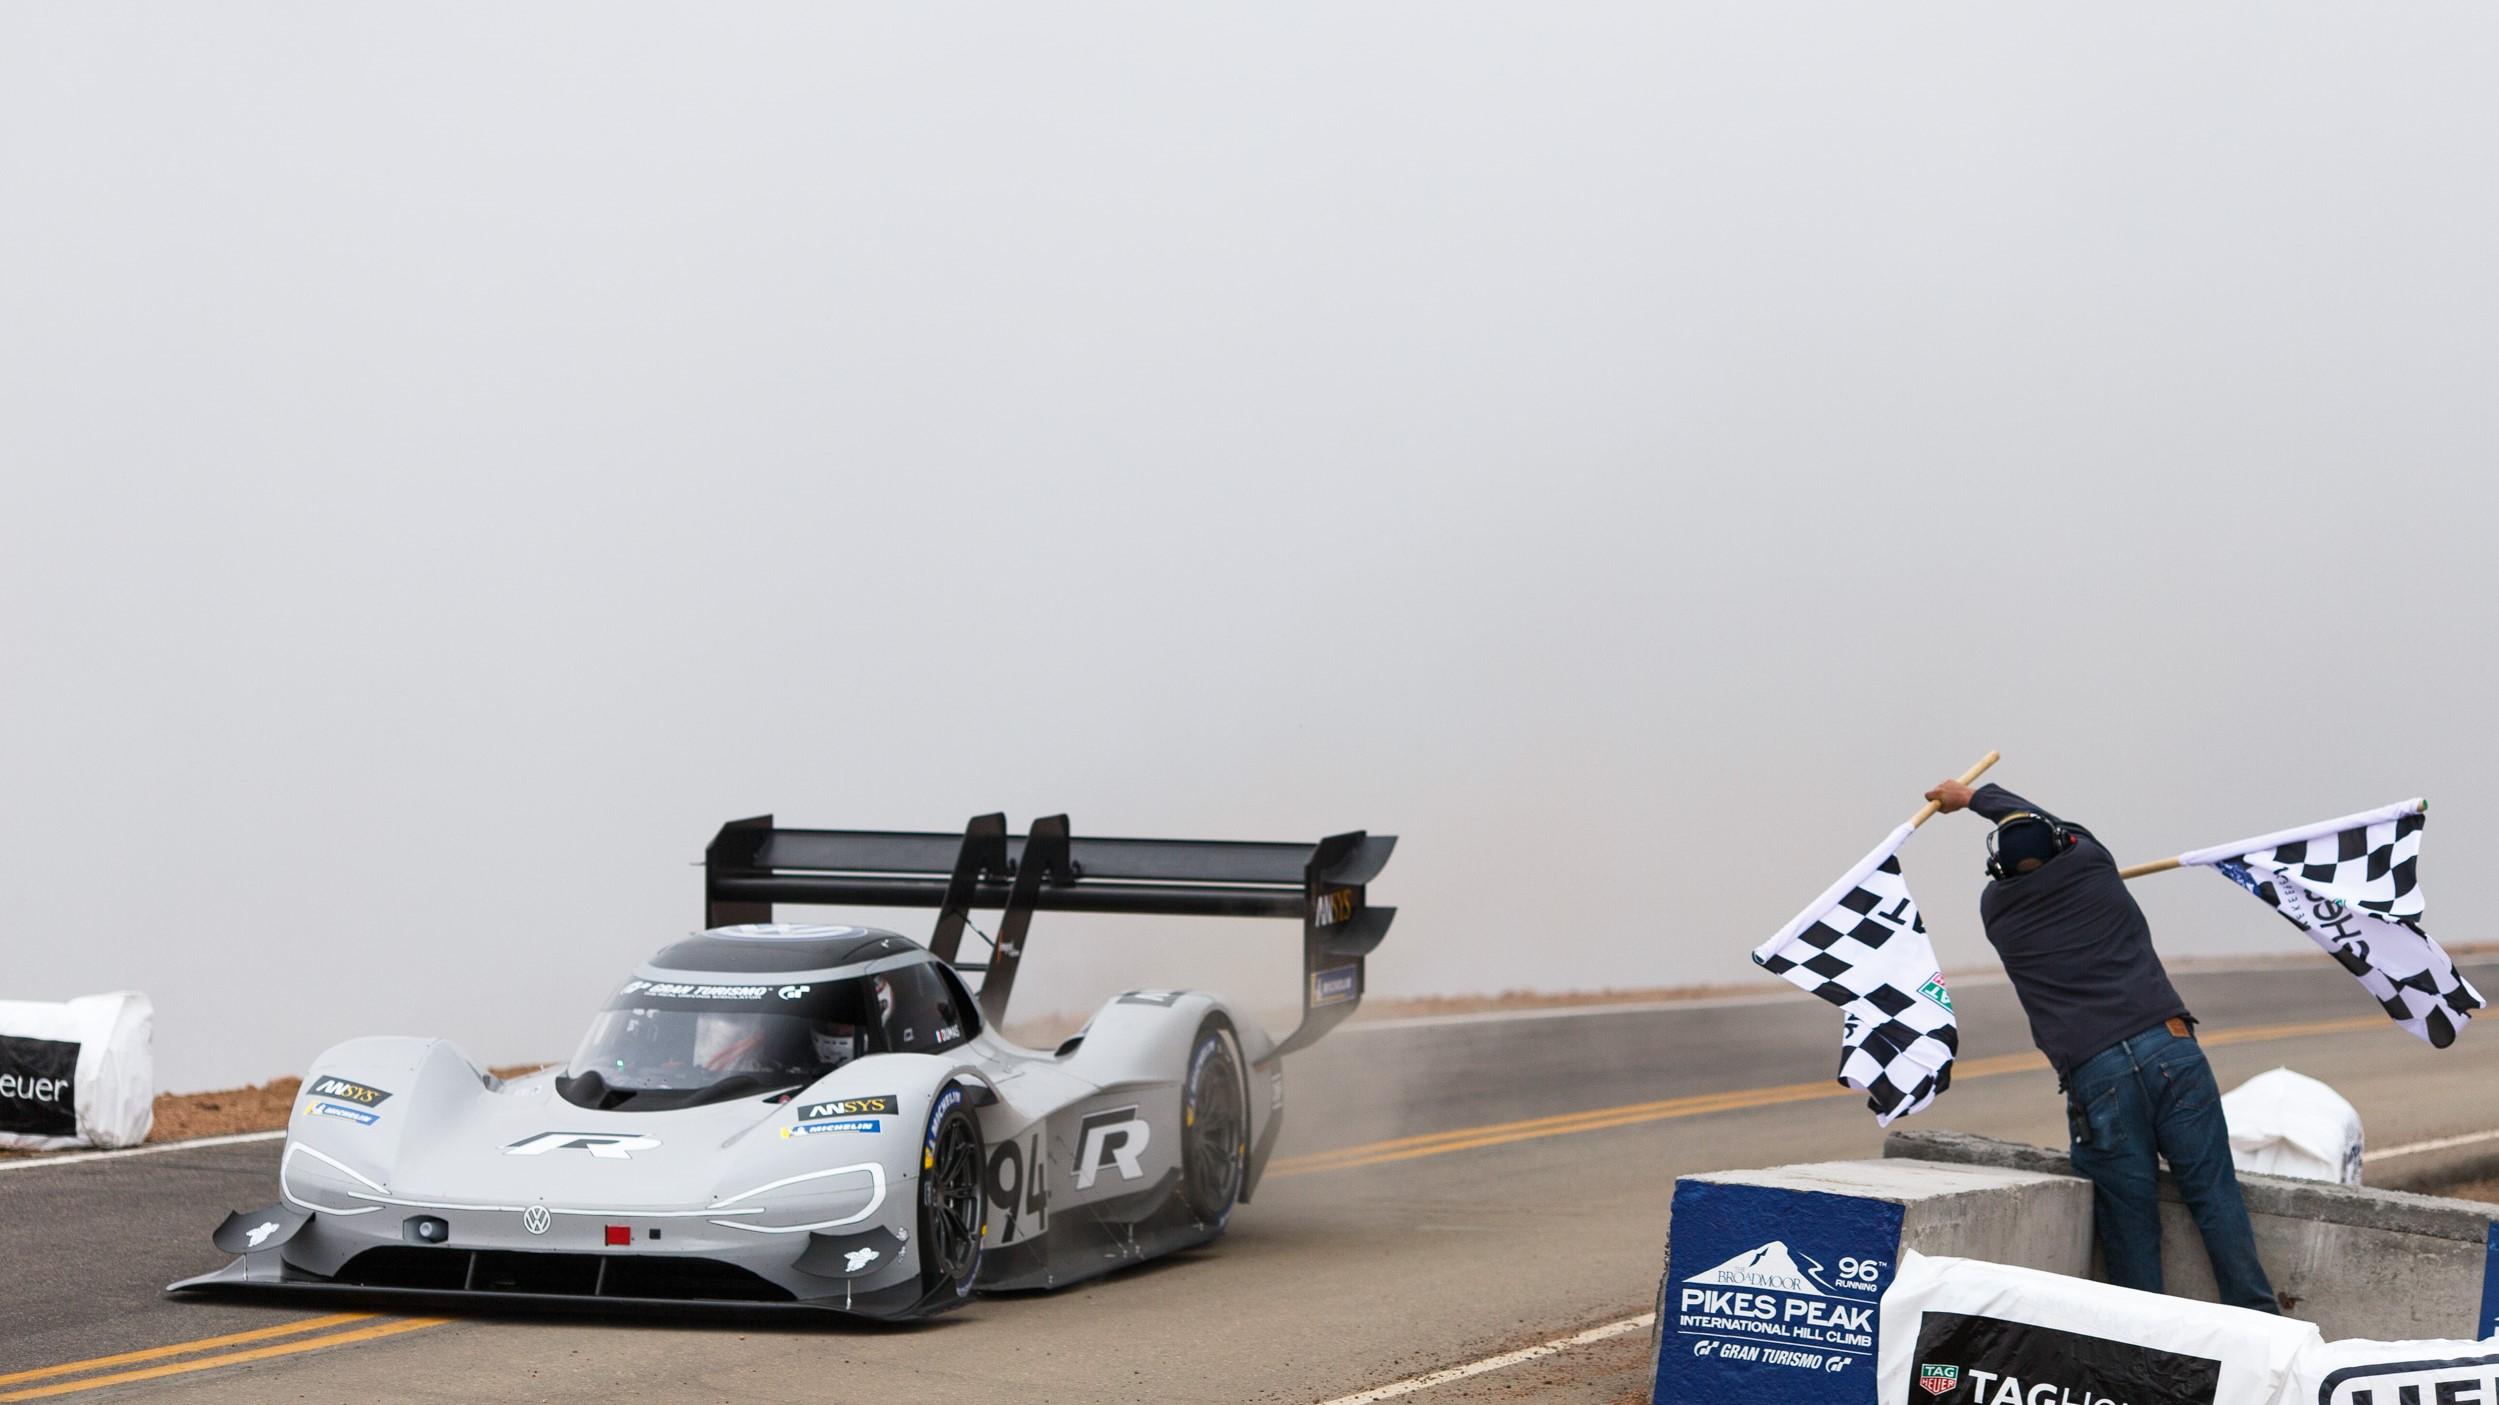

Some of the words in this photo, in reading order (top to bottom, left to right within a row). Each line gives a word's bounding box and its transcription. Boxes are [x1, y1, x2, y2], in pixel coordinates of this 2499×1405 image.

[1315, 890, 1351, 928] ANSYS
[649, 983, 693, 995] GRAN
[694, 985, 767, 997] TURISMO
[0, 1073, 69, 1102] euer
[316, 1080, 381, 1102] ANSYS
[809, 1099, 886, 1118] ANSYS
[931, 1091, 961, 1138] MICHELIN
[809, 1122, 873, 1134] MICHELIN
[500, 1131, 664, 1160] R
[1072, 1105, 1150, 1191] R
[987, 1131, 1051, 1244] 94
[1717, 1270, 1802, 1291] BROADMOOR
[1834, 1278, 1878, 1293] RUNNING
[1681, 1288, 1777, 1319] PIKES
[1784, 1298, 1875, 1333] PEAK
[1680, 1315, 1791, 1337] INTERNATIONAL
[1793, 1326, 1824, 1341] HILL
[1826, 1330, 1872, 1347] CLIMB
[1719, 1343, 1760, 1361] GRAN
[1761, 1348, 1823, 1370] TURISMO
[1924, 1366, 1955, 1378] TAG
[1921, 1378, 1956, 1394] HEUER
